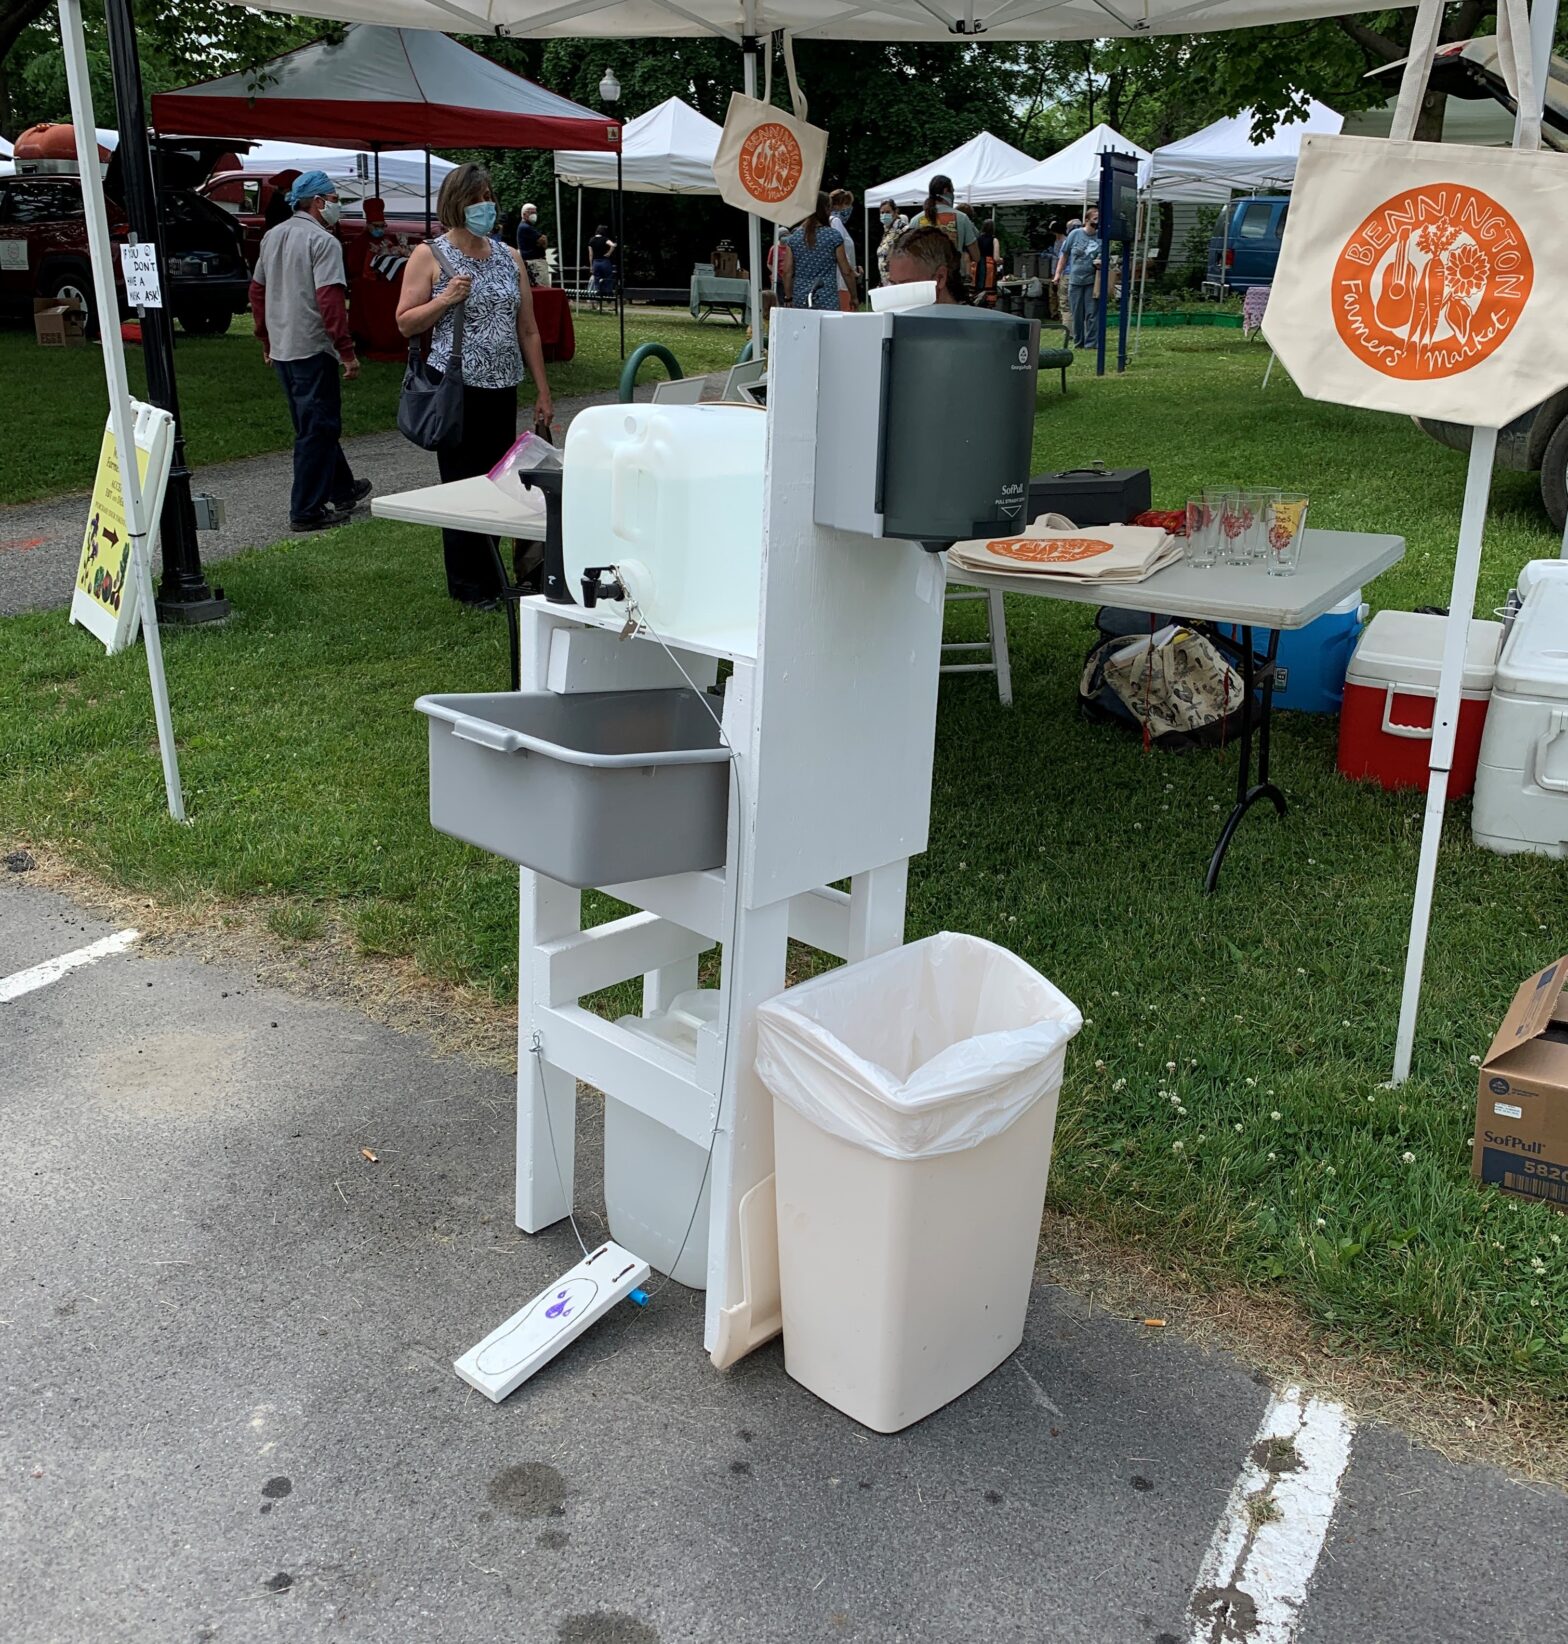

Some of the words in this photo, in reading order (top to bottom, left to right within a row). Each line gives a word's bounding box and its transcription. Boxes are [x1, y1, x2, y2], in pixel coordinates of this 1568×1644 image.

[1344, 191, 1525, 299] BENNINGTON
[139, 276, 146, 287] A
[1424, 308, 1511, 372] Market
[1001, 482, 1024, 496] SofPull
[1483, 1130, 1543, 1155] SofPull
